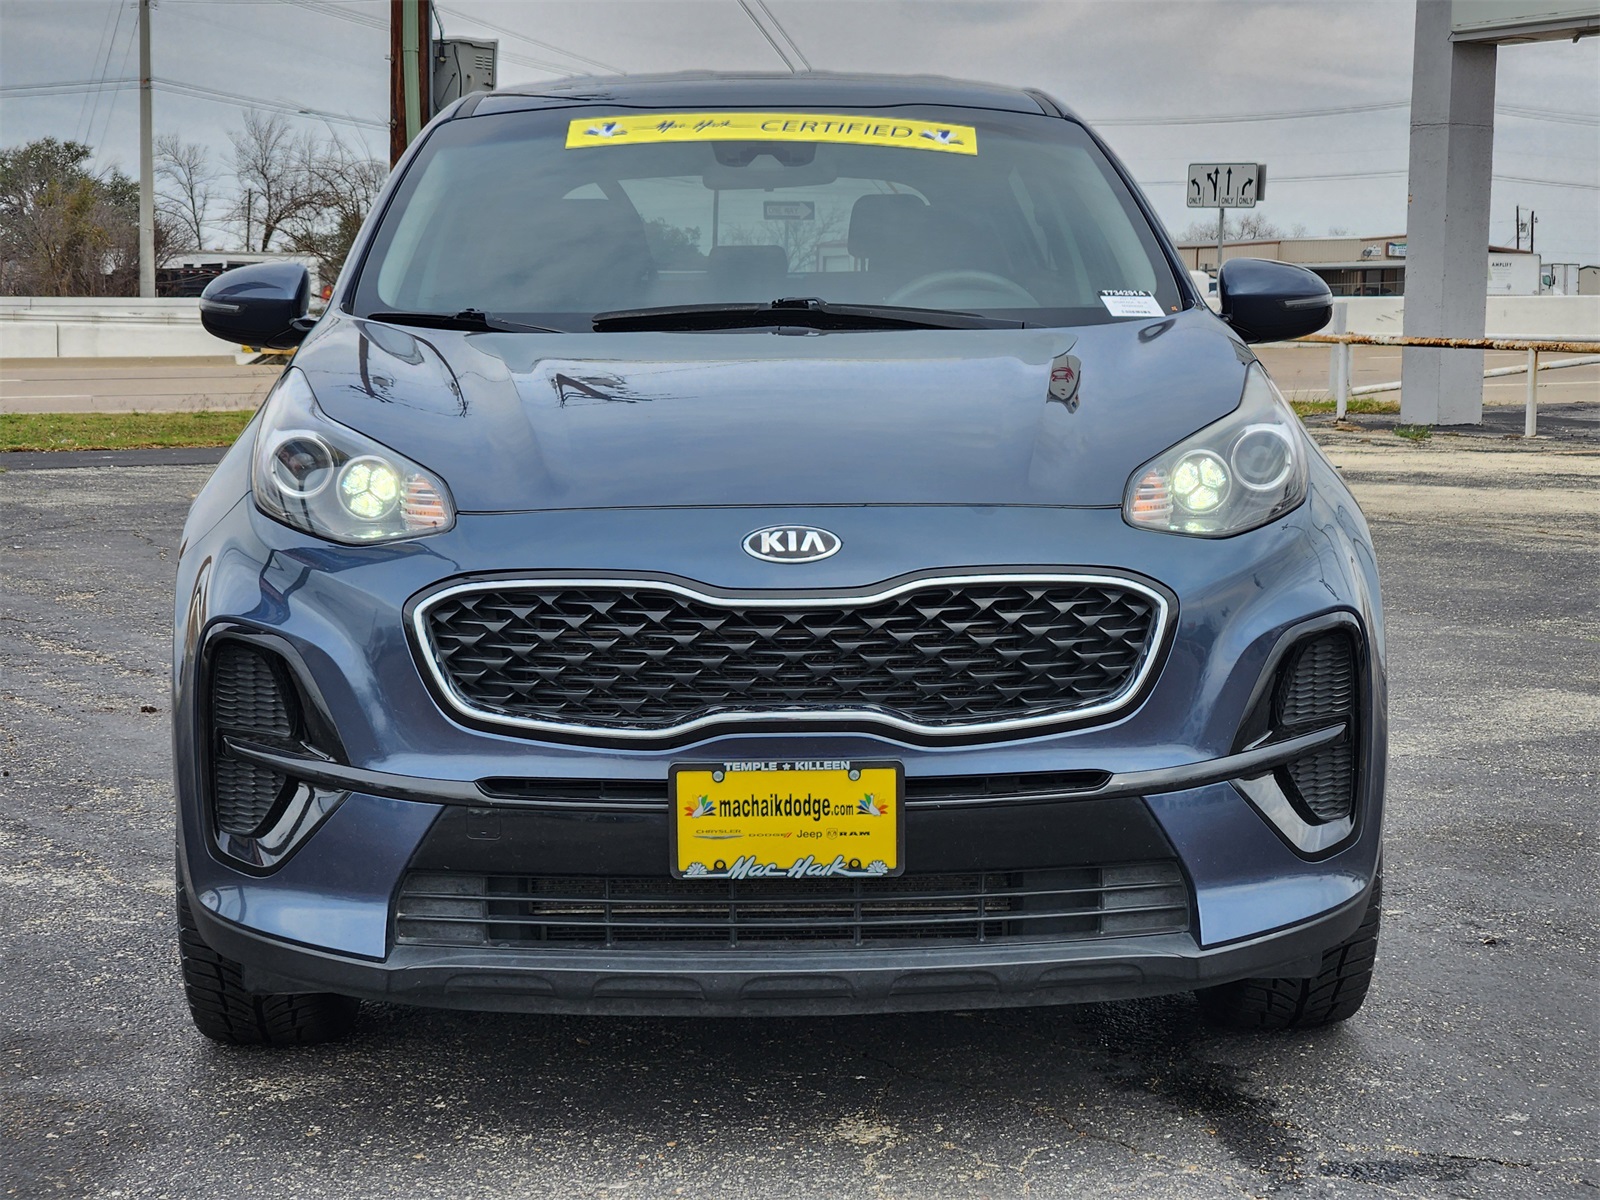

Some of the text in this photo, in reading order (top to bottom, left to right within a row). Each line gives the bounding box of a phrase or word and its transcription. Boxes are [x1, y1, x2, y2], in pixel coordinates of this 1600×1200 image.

[761, 119, 913, 138] CERTIFIED
[1188, 197, 1202, 205] ONLY
[1220, 197, 1235, 205] ONLY
[1238, 197, 1254, 205] ONLY
[760, 530, 826, 554] KIA
[723, 760, 851, 772] TEMPLE KILLEEN
[718, 793, 855, 822] machaikdodge.com
[796, 829, 823, 840] Jeep
[727, 854, 848, 880] Mac Haik
